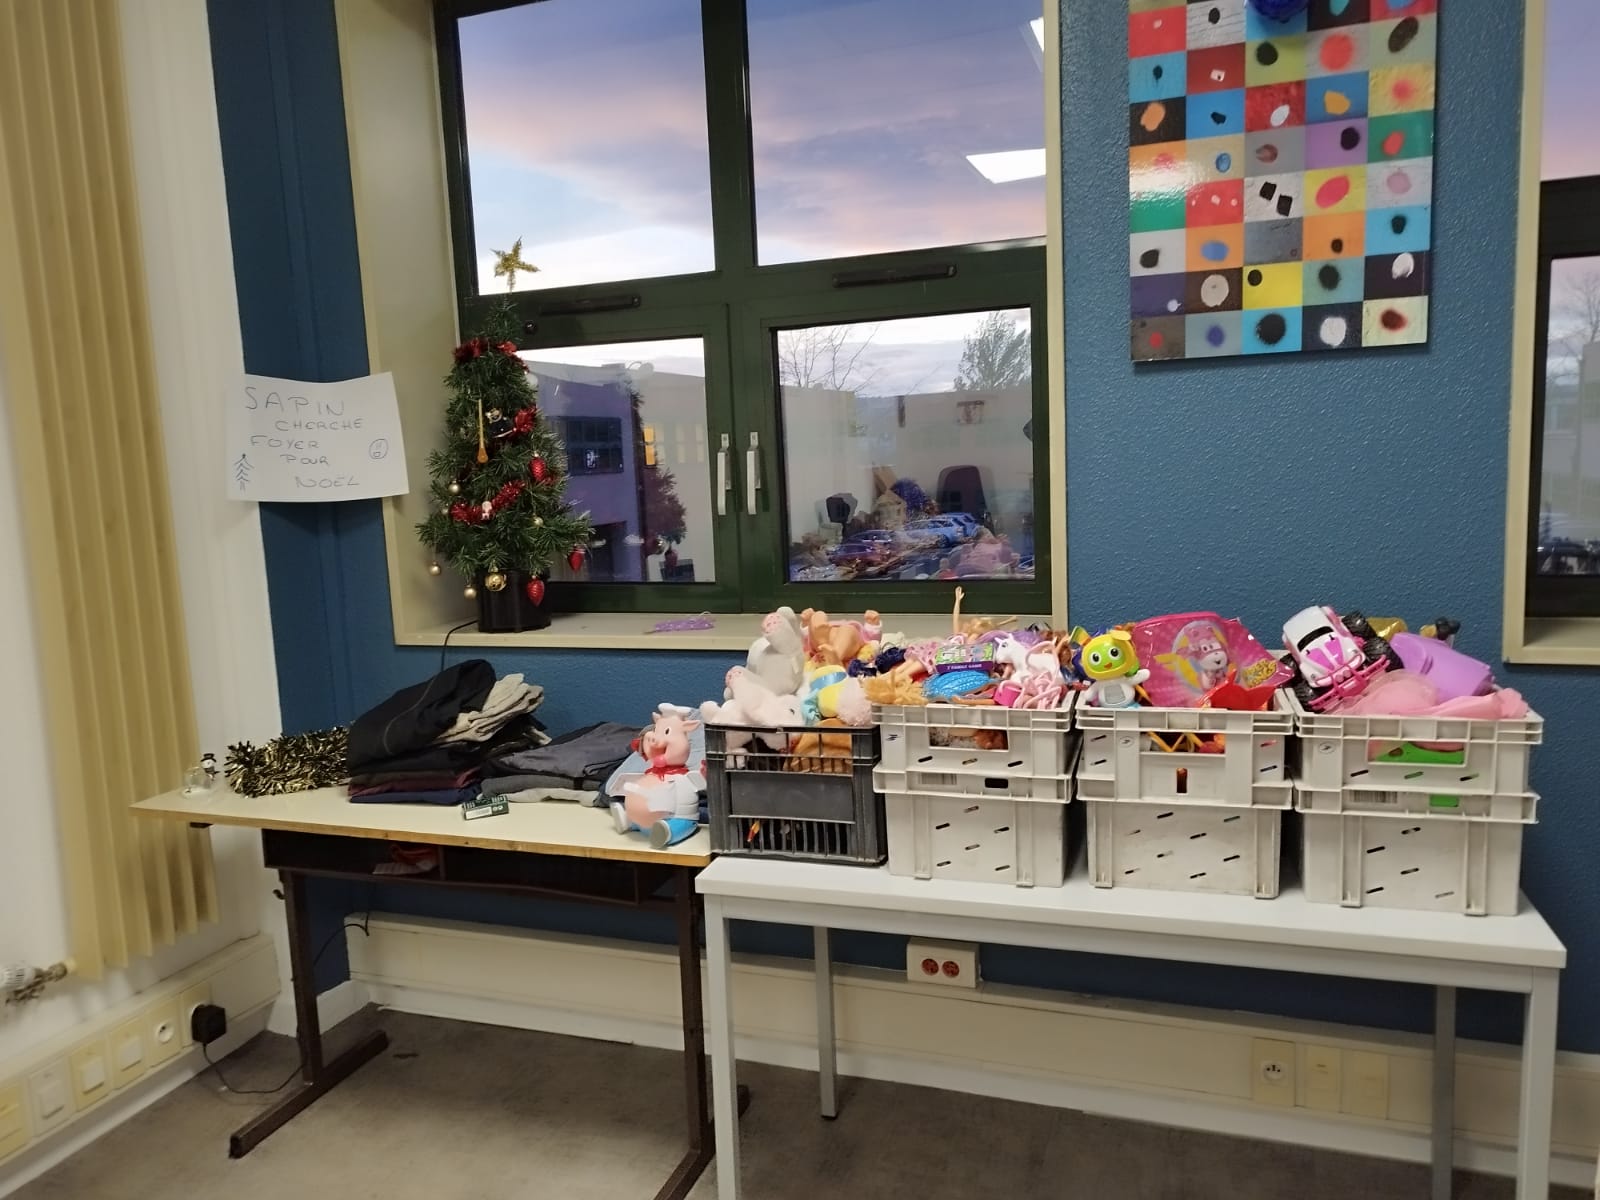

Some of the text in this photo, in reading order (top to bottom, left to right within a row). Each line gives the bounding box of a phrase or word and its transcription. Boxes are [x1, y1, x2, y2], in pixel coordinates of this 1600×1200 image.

[244, 386, 345, 416] SAPIN
[274, 417, 364, 432] CHERCHE
[250, 434, 320, 450] FOYER
[279, 453, 330, 469] POUR
